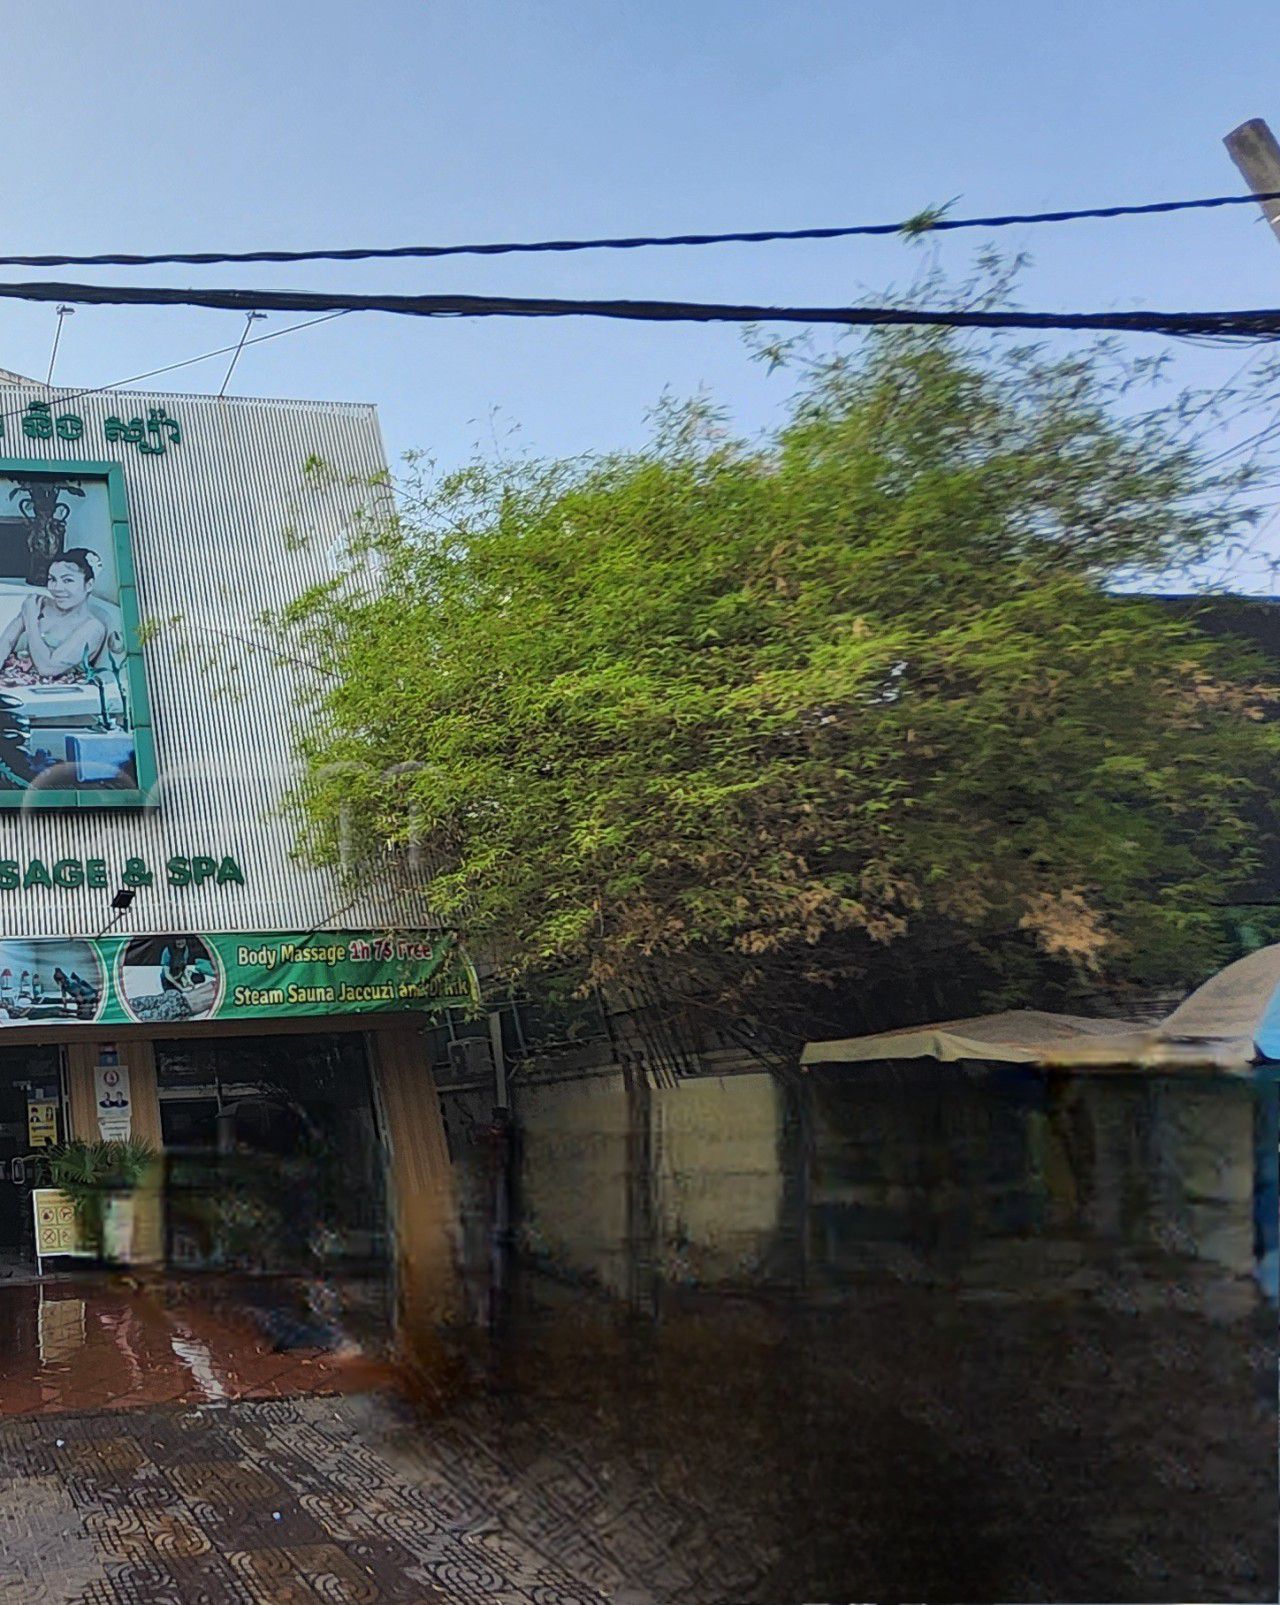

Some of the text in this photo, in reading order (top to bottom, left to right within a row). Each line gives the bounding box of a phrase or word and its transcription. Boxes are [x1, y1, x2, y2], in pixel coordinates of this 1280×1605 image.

[122, 857, 153, 888] &
[168, 856, 245, 886] SPA
[238, 946, 277, 969] Body
[281, 944, 346, 965] Massage
[233, 986, 284, 1006] Steam
[288, 984, 334, 1004] Sauna
[338, 981, 395, 1001] Jaccuzi
